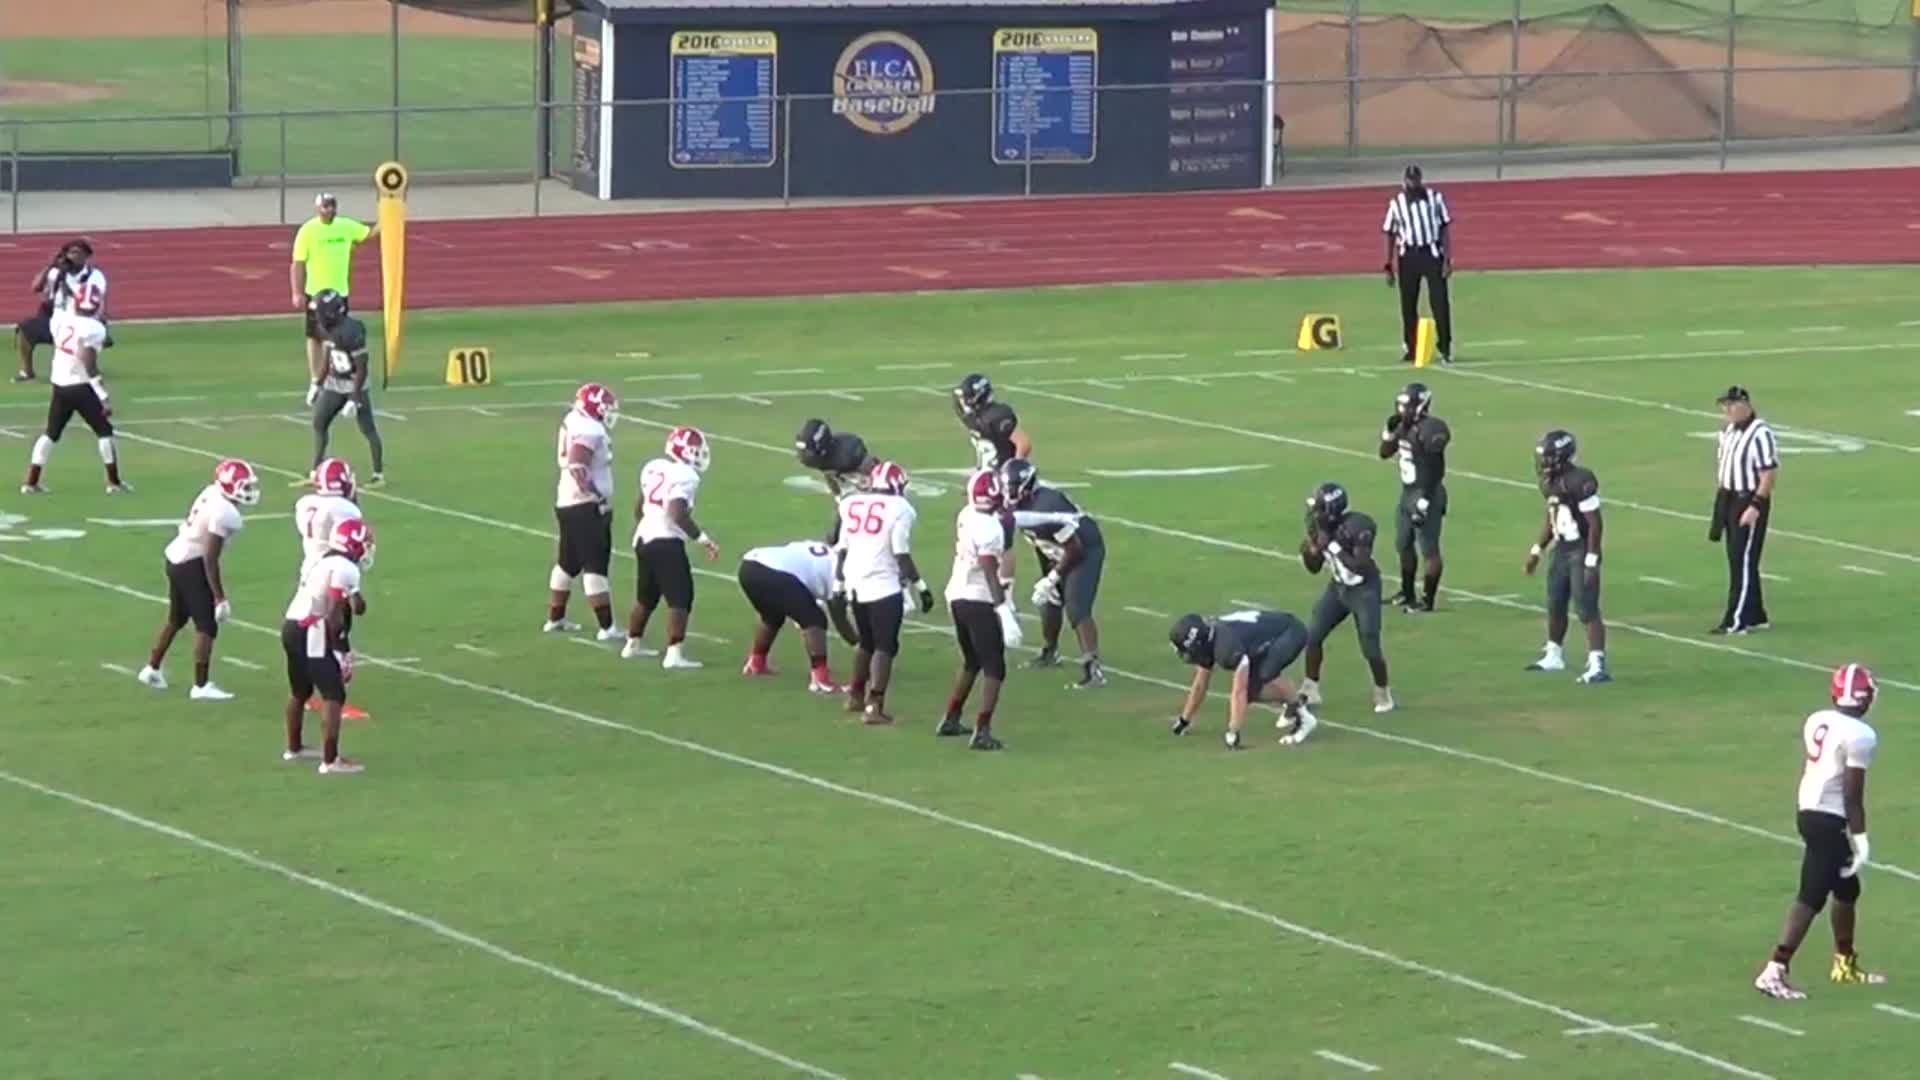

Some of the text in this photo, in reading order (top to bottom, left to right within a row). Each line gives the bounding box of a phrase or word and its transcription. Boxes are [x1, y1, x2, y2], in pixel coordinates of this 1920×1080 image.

[855, 60, 916, 78] ELCA
[832, 94, 936, 113] Baseball
[1312, 317, 1338, 349] G
[455, 351, 487, 384] 10
[306, 506, 318, 538] 7
[847, 501, 886, 535] 56
[1808, 724, 1829, 764] 9
